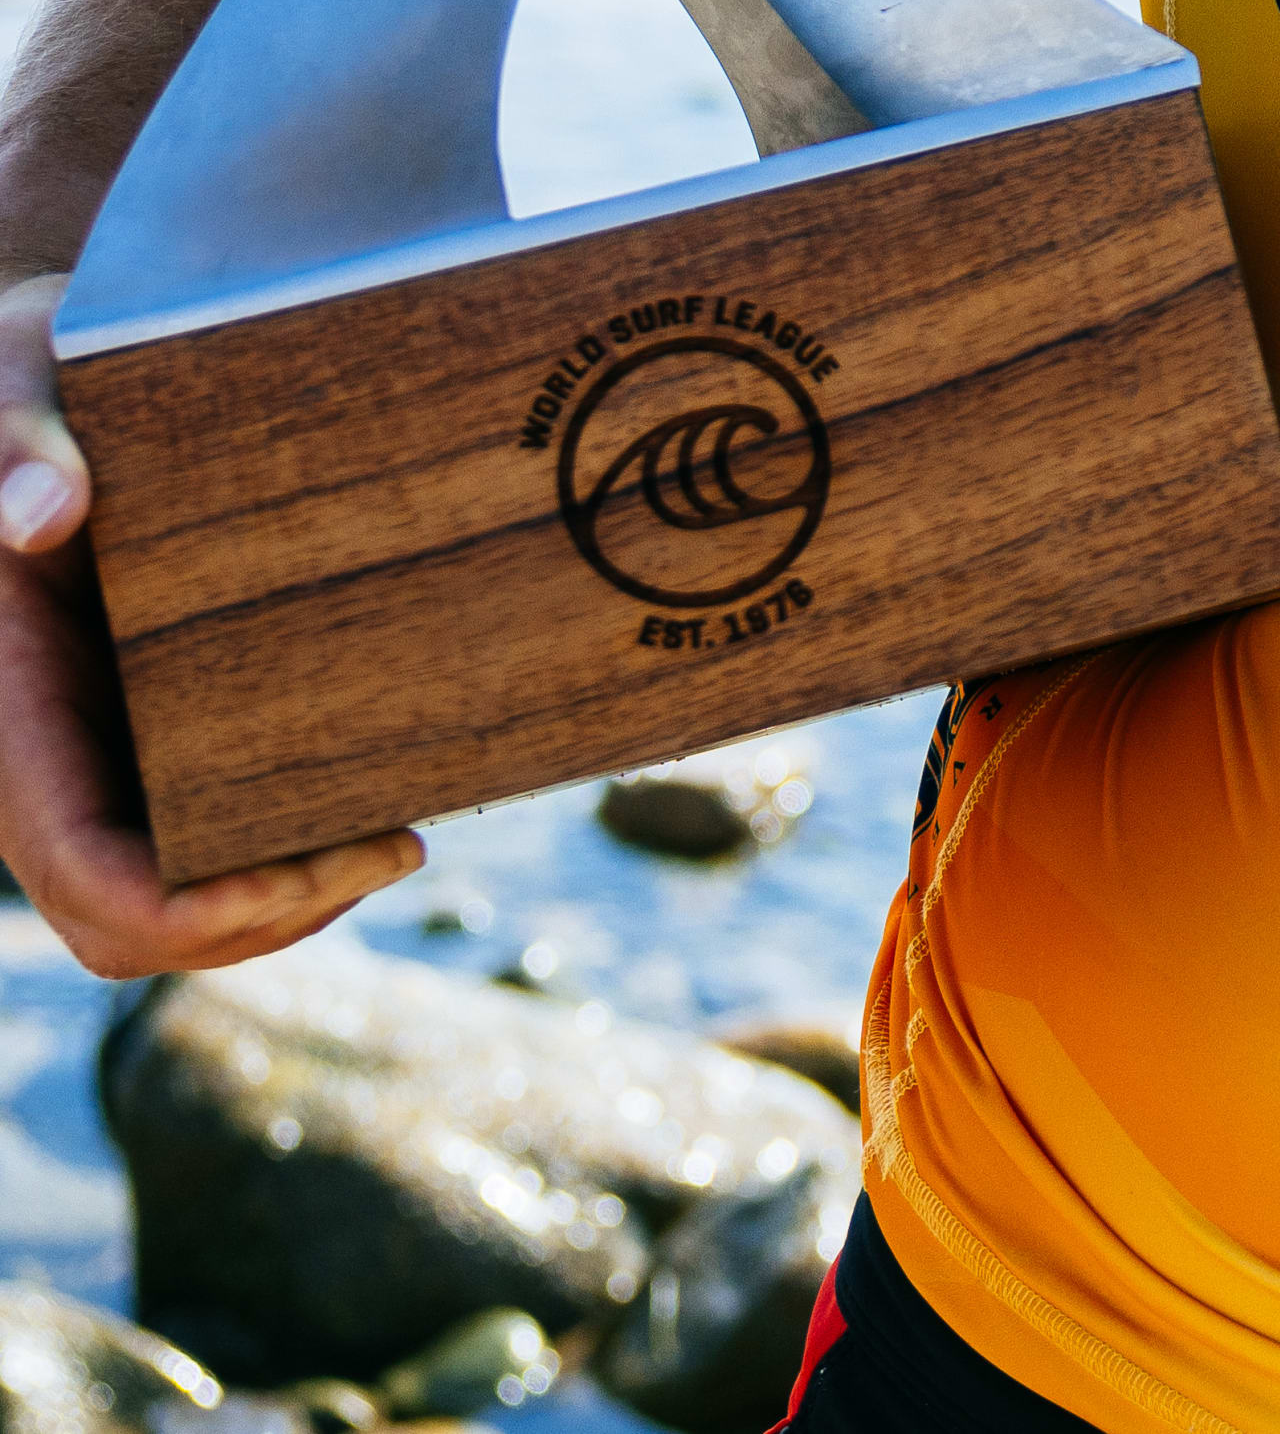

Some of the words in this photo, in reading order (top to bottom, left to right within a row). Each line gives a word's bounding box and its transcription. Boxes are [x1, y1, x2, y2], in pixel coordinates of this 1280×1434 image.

[520, 334, 608, 449] WORLD
[607, 295, 705, 344] SURF
[714, 296, 841, 384] LEAGUE
[638, 616, 716, 650] EST.
[723, 578, 815, 646] 1976
